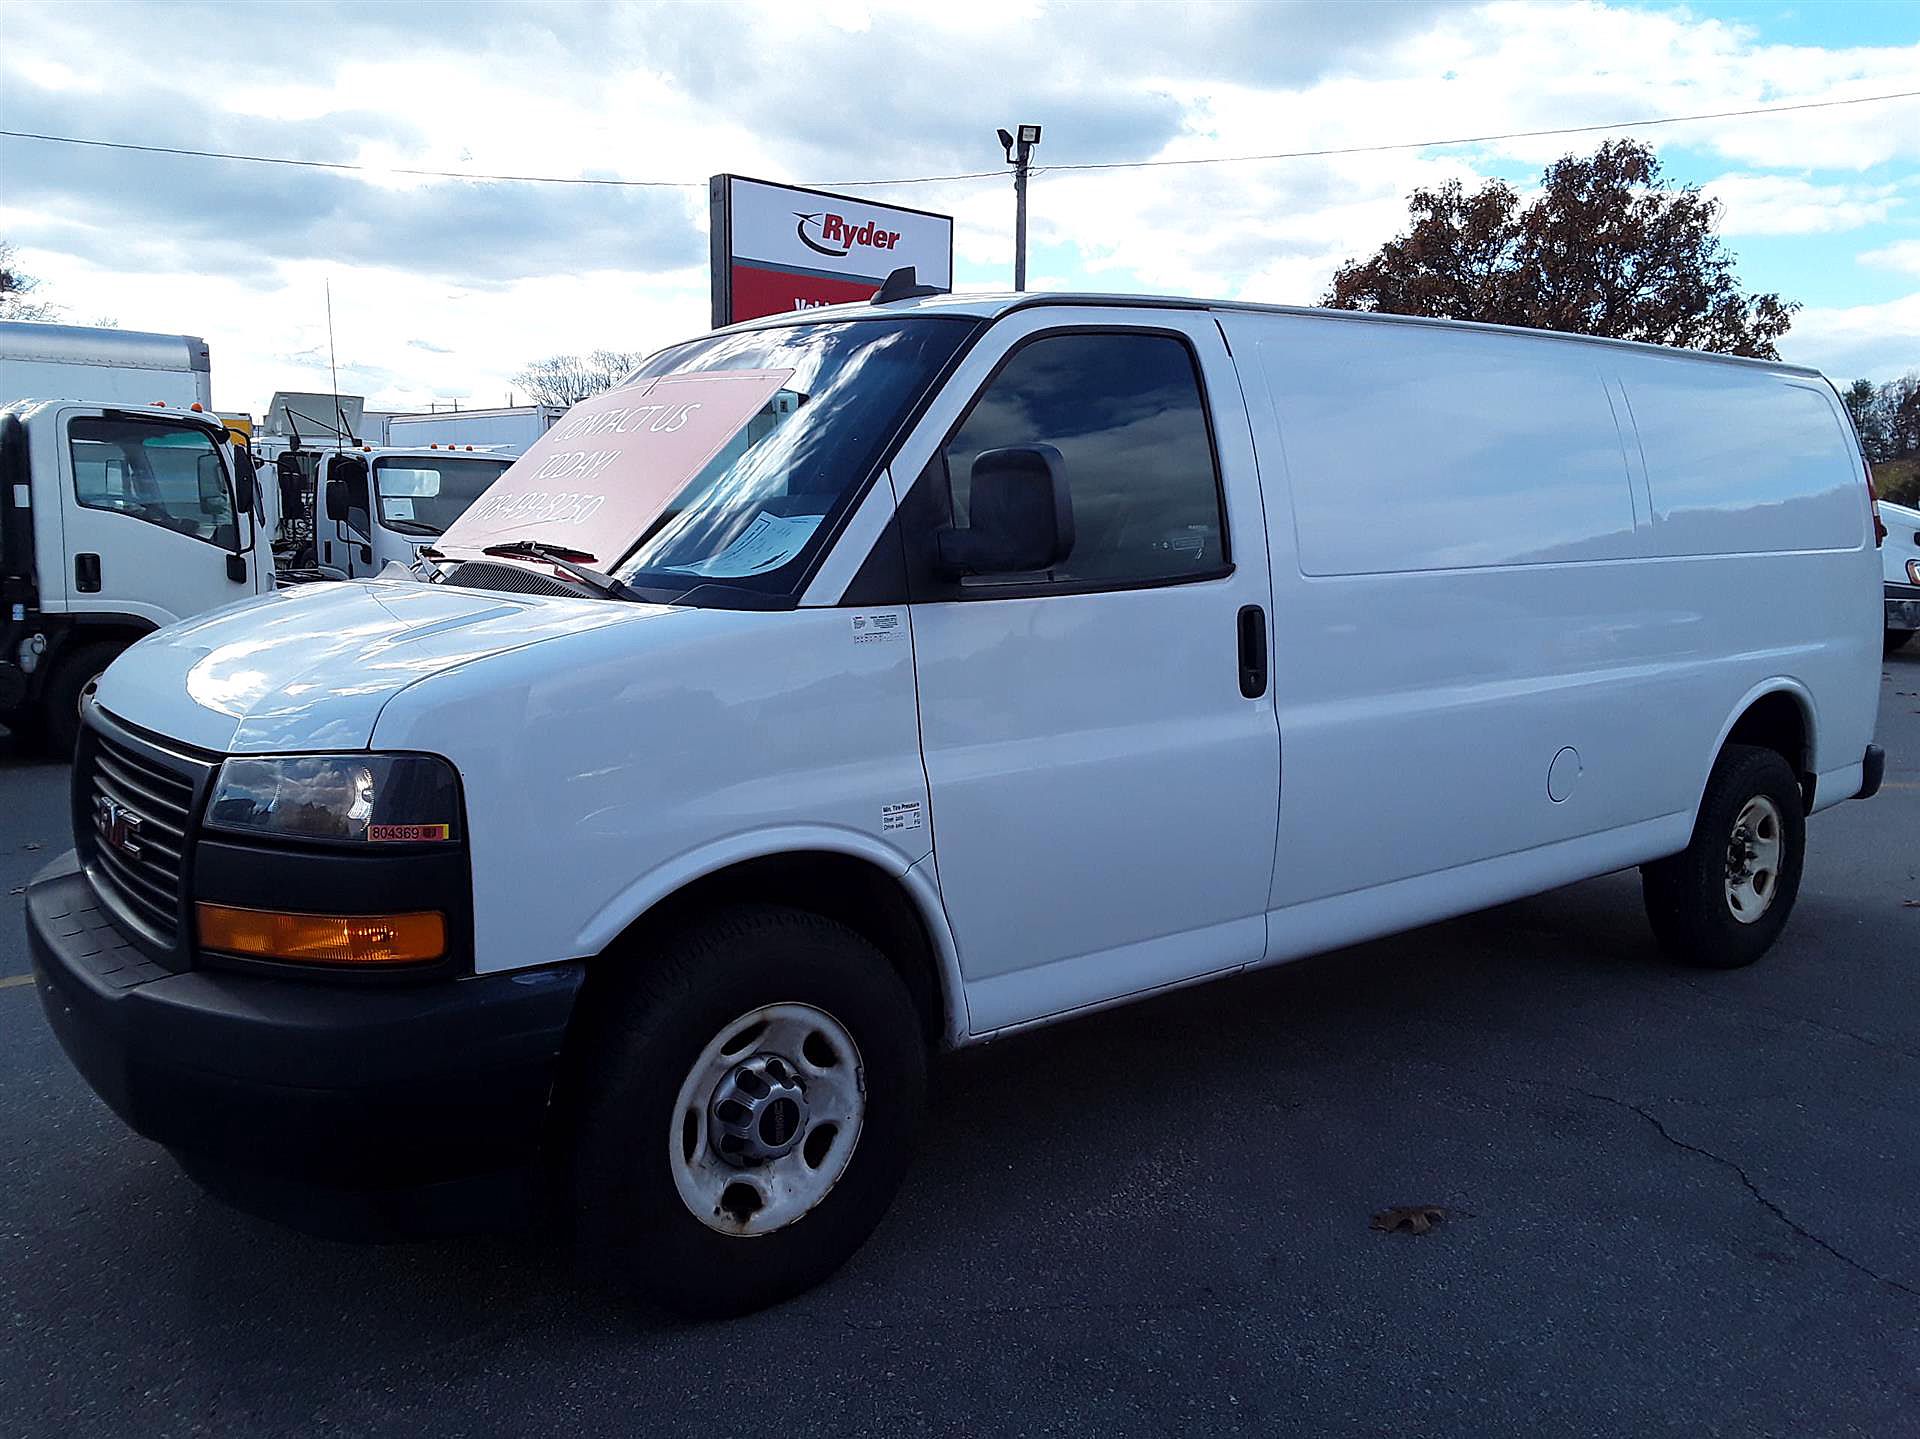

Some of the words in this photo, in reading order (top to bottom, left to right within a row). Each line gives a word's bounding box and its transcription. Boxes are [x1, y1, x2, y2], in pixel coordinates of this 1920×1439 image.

[822, 213, 901, 250] Ryder
[554, 405, 665, 442] CONTACT
[649, 403, 701, 433] US
[529, 449, 623, 480] TODAY!
[466, 491, 605, 524] 978-499-8250
[372, 826, 420, 839] 804369
